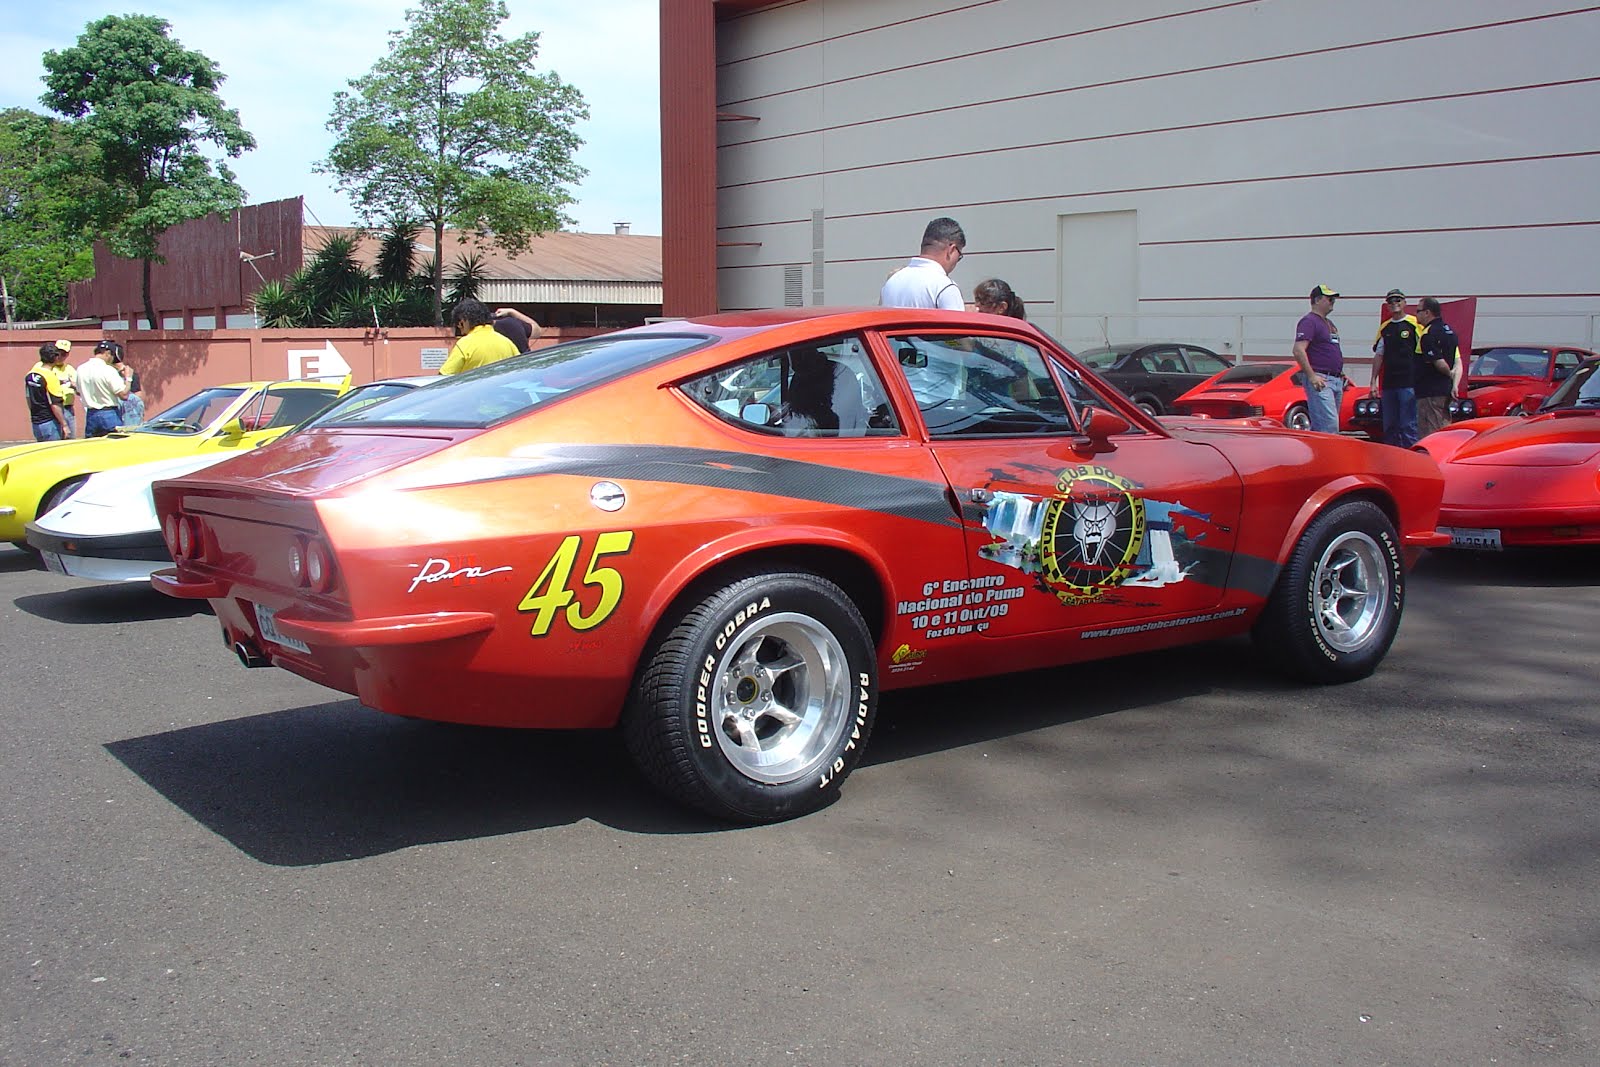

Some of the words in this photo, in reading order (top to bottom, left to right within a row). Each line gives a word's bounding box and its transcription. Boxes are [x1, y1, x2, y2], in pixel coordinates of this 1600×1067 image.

[300, 356, 321, 382] E
[1043, 500, 1061, 559] PUMA
[1057, 466, 1089, 492] CLUB
[1093, 466, 1116, 480] DO
[1380, 531, 1402, 579] RADIAL
[517, 530, 634, 637] 45
[942, 575, 1005, 593] Encontro
[897, 594, 963, 615] Nacional
[965, 591, 984, 606] do
[986, 587, 1024, 602] Puma
[912, 615, 928, 629] 10
[931, 615, 942, 627] e
[943, 611, 959, 625] 11
[960, 603, 1008, 622] Out/09
[925, 629, 943, 639] Foz
[943, 626, 956, 637] do
[956, 621, 989, 635] Iguçu
[1081, 607, 1247, 639] www.pumaclubcataratas.com.br
[1309, 617, 1337, 662] COOPER
[697, 654, 717, 748] COOPER
[715, 597, 771, 650] COBRA
[845, 672, 870, 752] RADIAL
[819, 757, 845, 788] G/T
